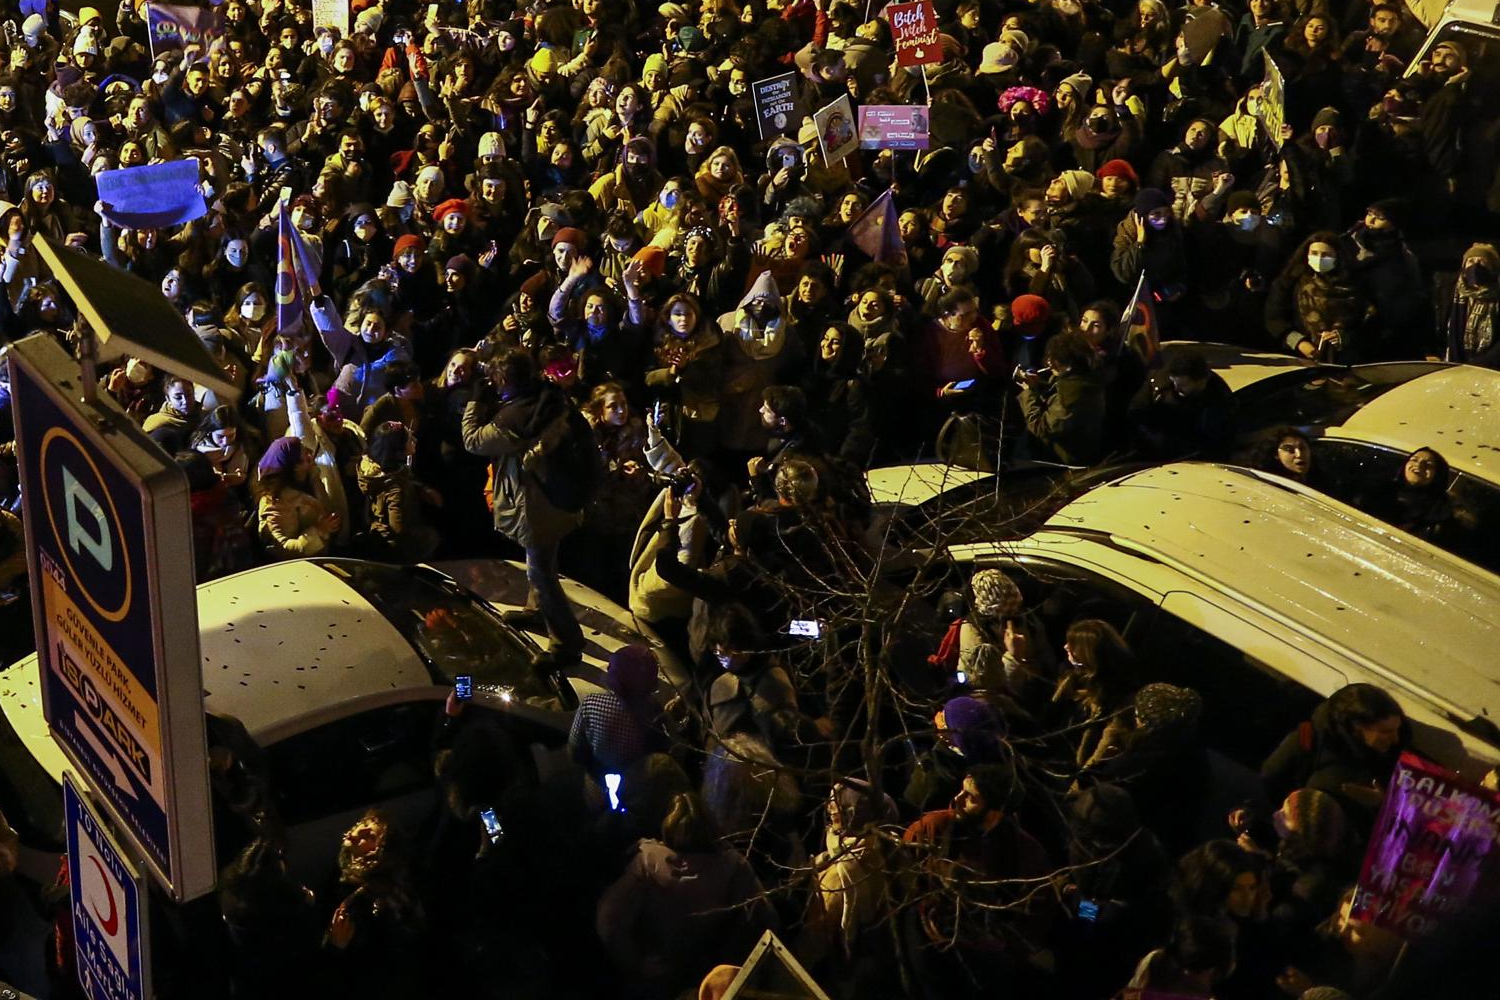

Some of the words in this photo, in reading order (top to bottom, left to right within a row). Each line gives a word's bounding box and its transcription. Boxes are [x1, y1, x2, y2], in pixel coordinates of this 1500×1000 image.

[894, 3, 925, 28] Bitch
[899, 20, 927, 41] Witch
[894, 28, 938, 52] Feminist
[763, 102, 794, 119] EARTH
[62, 465, 113, 572] P
[55, 613, 84, 653] GÜLER
[84, 649, 112, 686] YÜZLÜ
[66, 606, 105, 661] GÜVENLE
[78, 803, 92, 833] 10
[94, 830, 124, 882] Nolu
[76, 902, 96, 945] Aile
